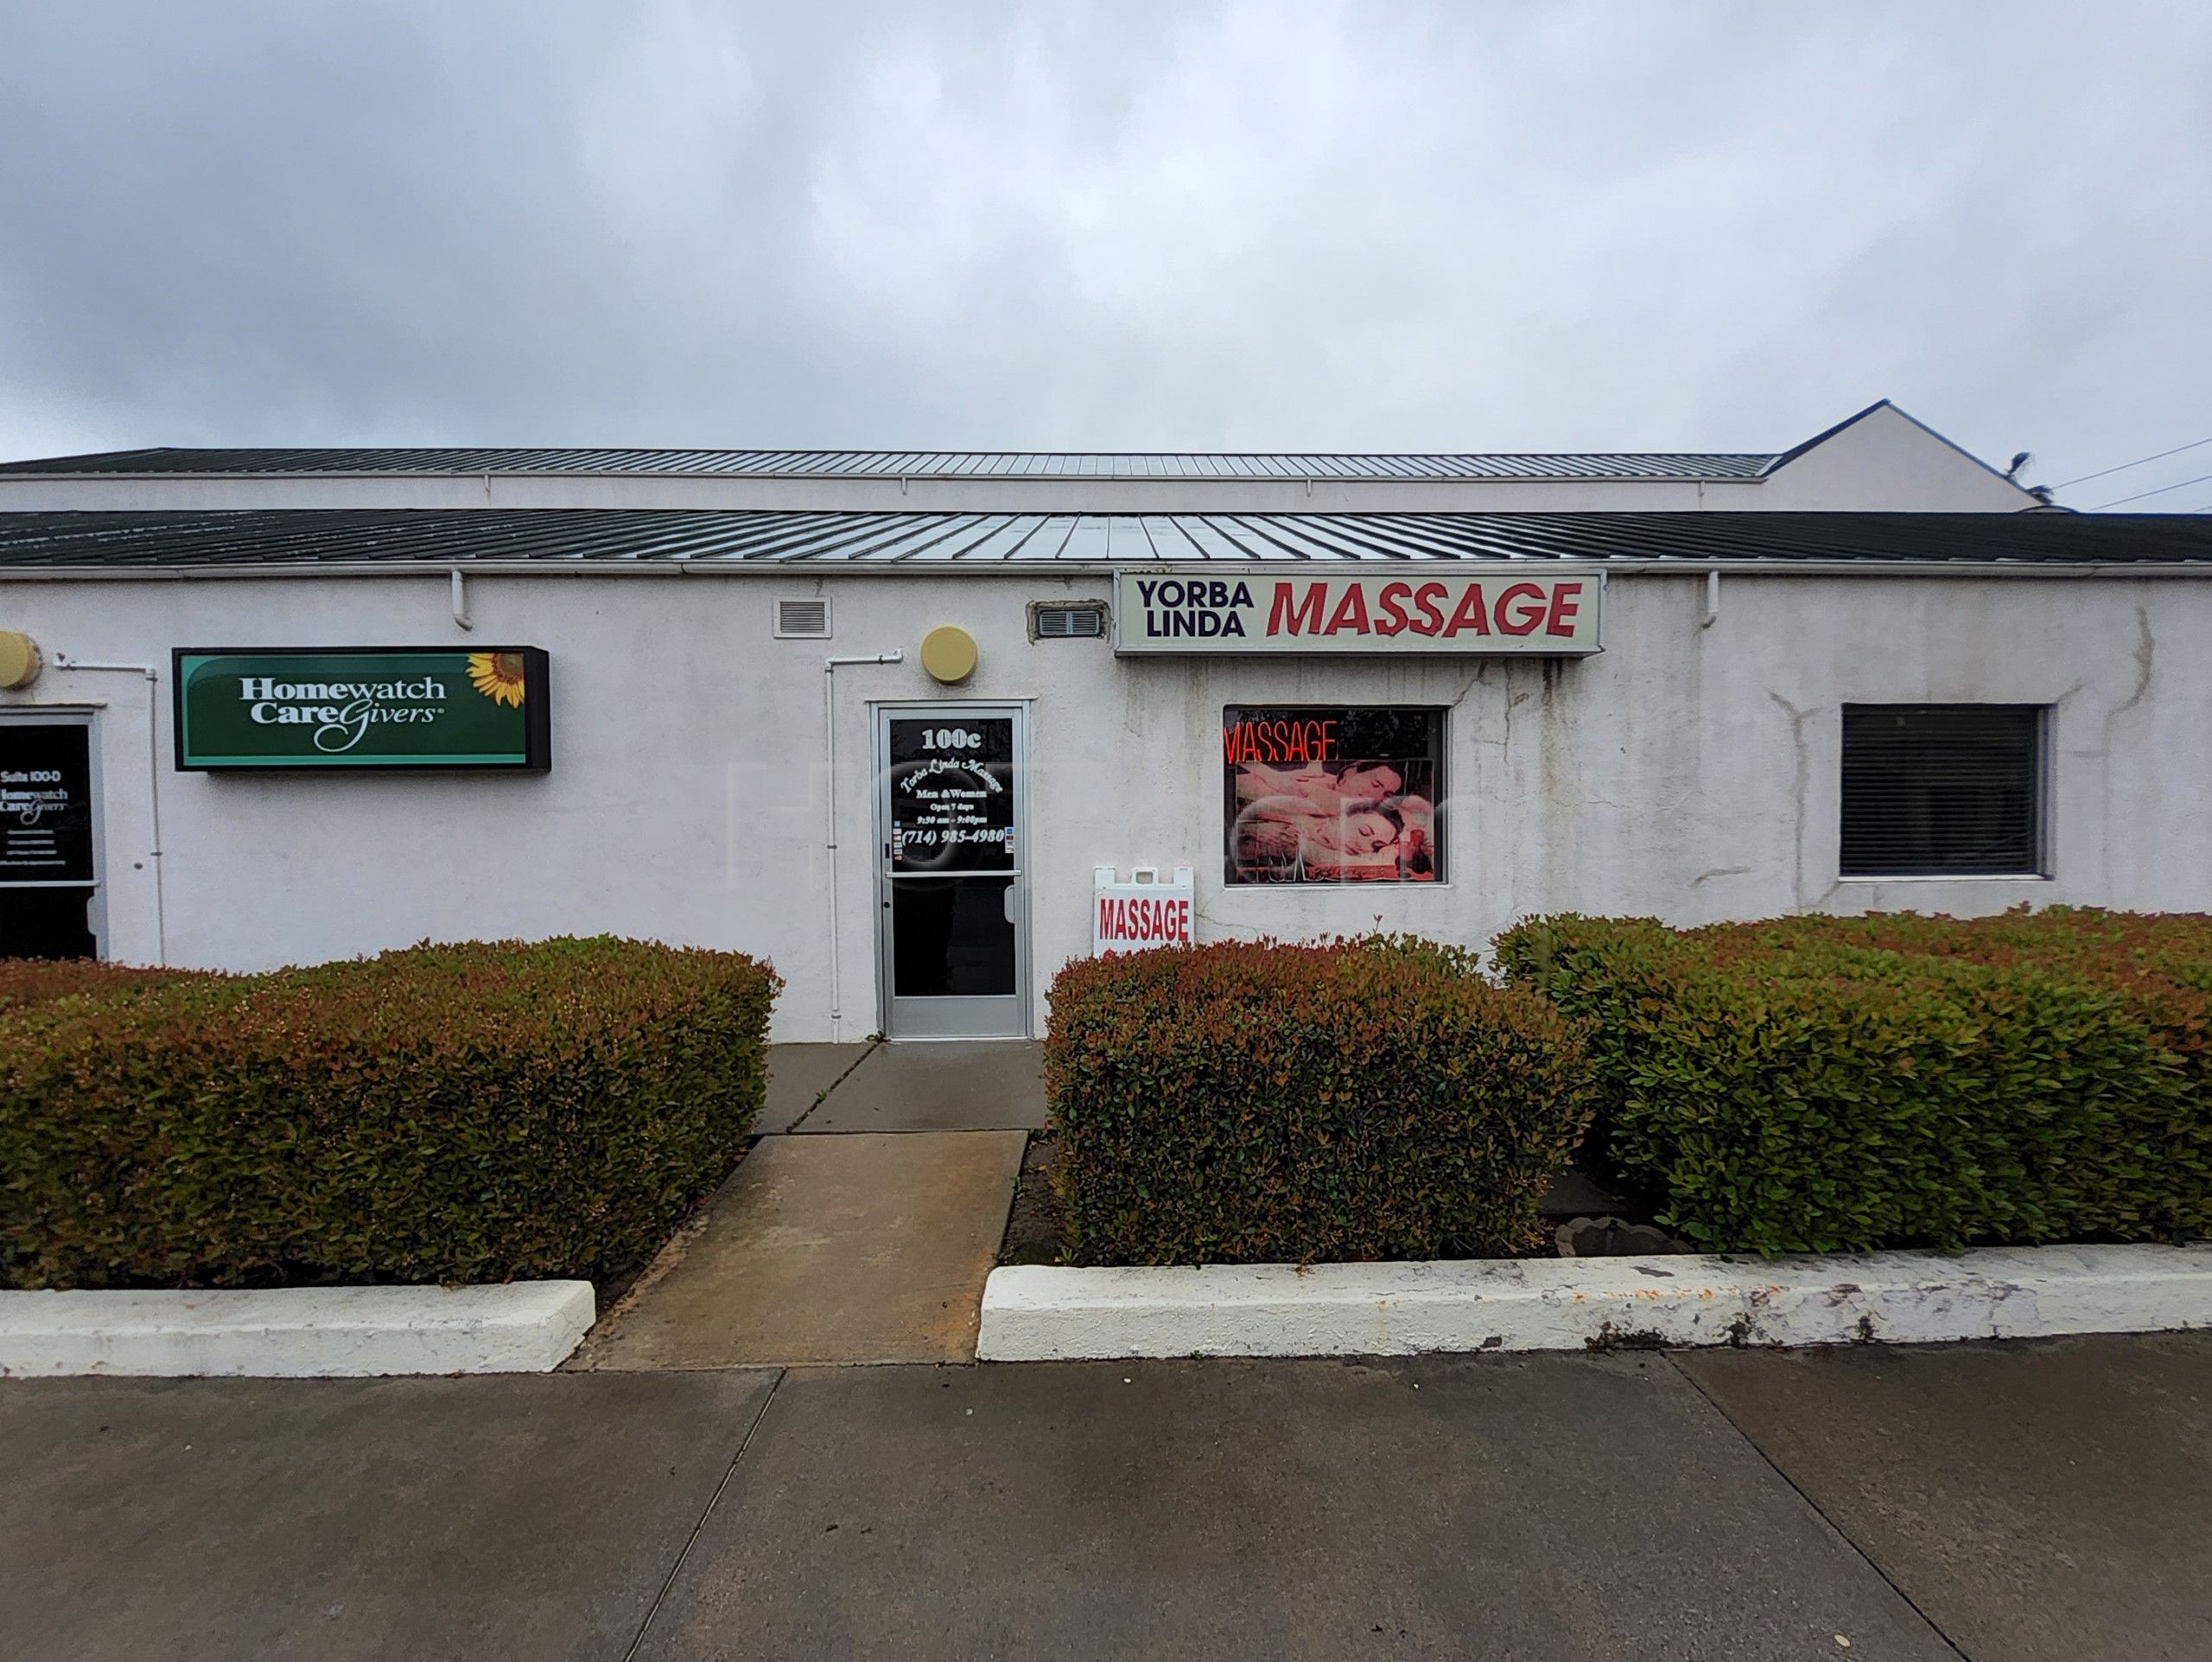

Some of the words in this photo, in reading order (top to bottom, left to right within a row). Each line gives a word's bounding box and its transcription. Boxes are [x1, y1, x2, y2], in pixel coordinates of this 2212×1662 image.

[1136, 581, 1255, 608] YORBA
[1266, 582, 1583, 638] MASSAGE
[1147, 609, 1246, 638] LINDA
[238, 676, 447, 701] Homewatch
[921, 728, 982, 750] 100c
[928, 757, 960, 774] Linda
[961, 759, 1004, 793] Massage
[916, 789, 939, 799] Men
[930, 803, 950, 812] Open
[957, 803, 975, 812] days
[902, 831, 938, 846] (714)
[940, 829, 1005, 844] 985-4980
[1099, 898, 1189, 942] MASSAGE
